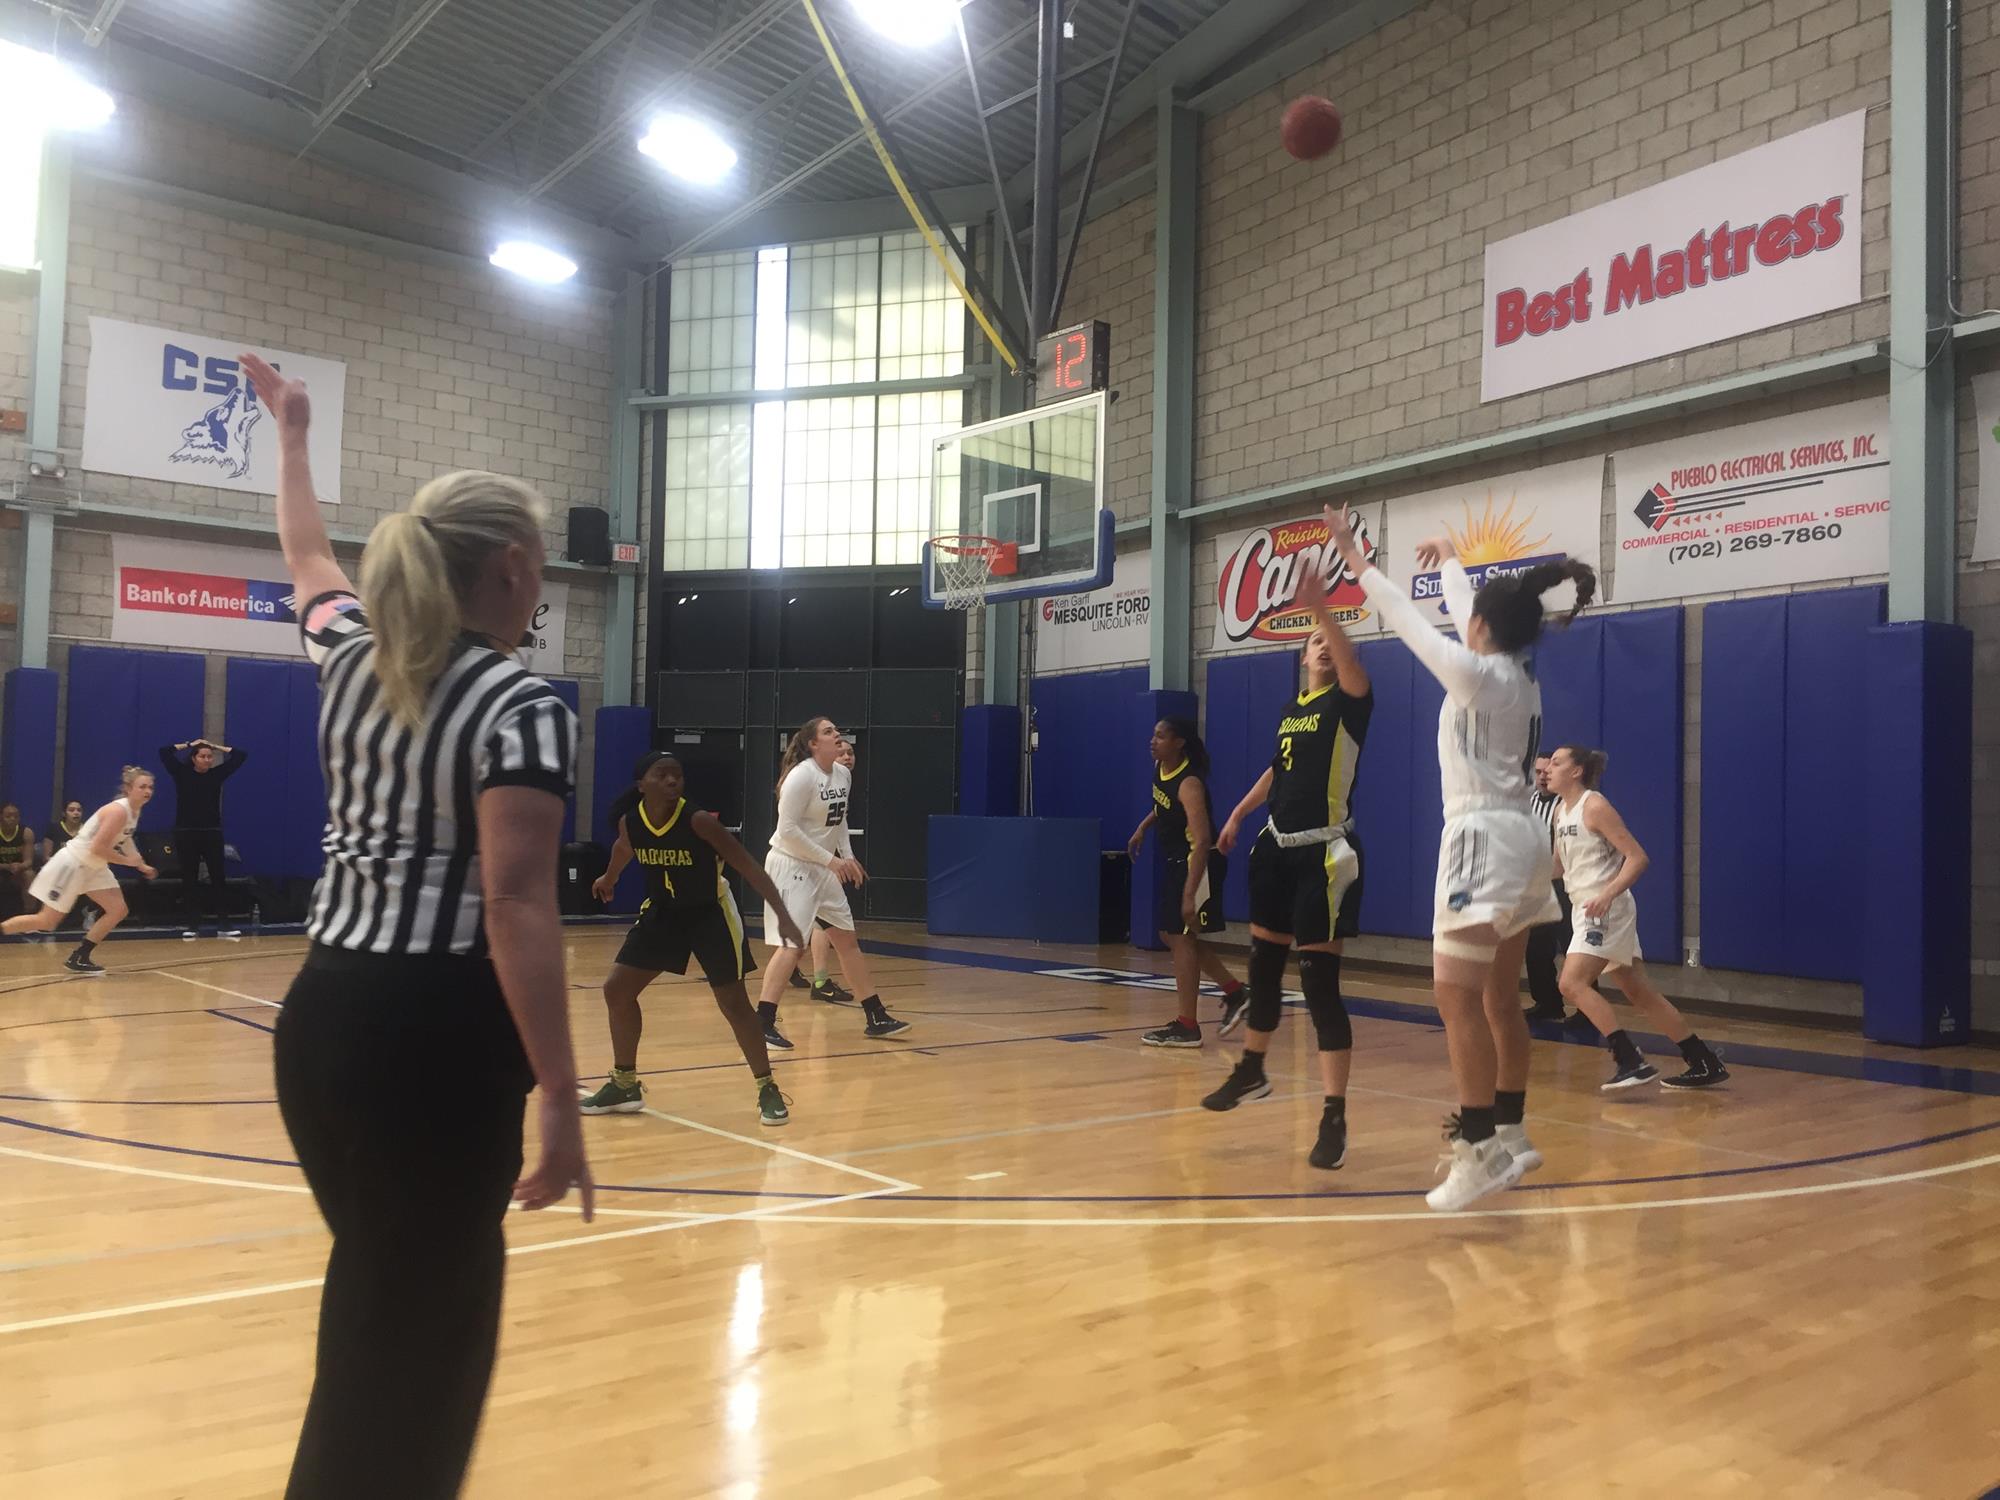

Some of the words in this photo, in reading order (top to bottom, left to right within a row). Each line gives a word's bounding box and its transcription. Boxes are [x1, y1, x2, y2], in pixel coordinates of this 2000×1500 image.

[1495, 267, 1592, 347] Best
[1603, 195, 1844, 315] Mattress
[1056, 332, 1086, 388] 12
[1671, 464, 1717, 490] PUEBLO
[1720, 451, 1786, 480] ELECTRICAL
[1790, 440, 1848, 469] SERVICES,
[1853, 434, 1878, 459] INC.
[1275, 524, 1330, 551] Raising
[1622, 528, 1710, 550] COMMERCIAL
[1724, 511, 1818, 535] RESIDENTIAL
[1834, 499, 1890, 519] SERVIC
[1669, 540, 1722, 564] (702)
[1730, 523, 1842, 553] 269-7860
[127, 583, 175, 605] Bank
[178, 589, 198, 606] of
[199, 590, 275, 614] America
[1415, 573, 1481, 597] SUT
[532, 603, 549, 630] e
[1054, 602, 1113, 625] MESQUITE
[1116, 596, 1150, 615] FORD
[1055, 599, 1069, 609] Ken
[1092, 616, 1131, 632] LINCOLN
[1136, 613, 1149, 626] RV
[1270, 615, 1312, 630] CHICKEN
[1315, 608, 1359, 625] GERS
[825, 801, 846, 827] 25
[664, 870, 675, 898] 4
